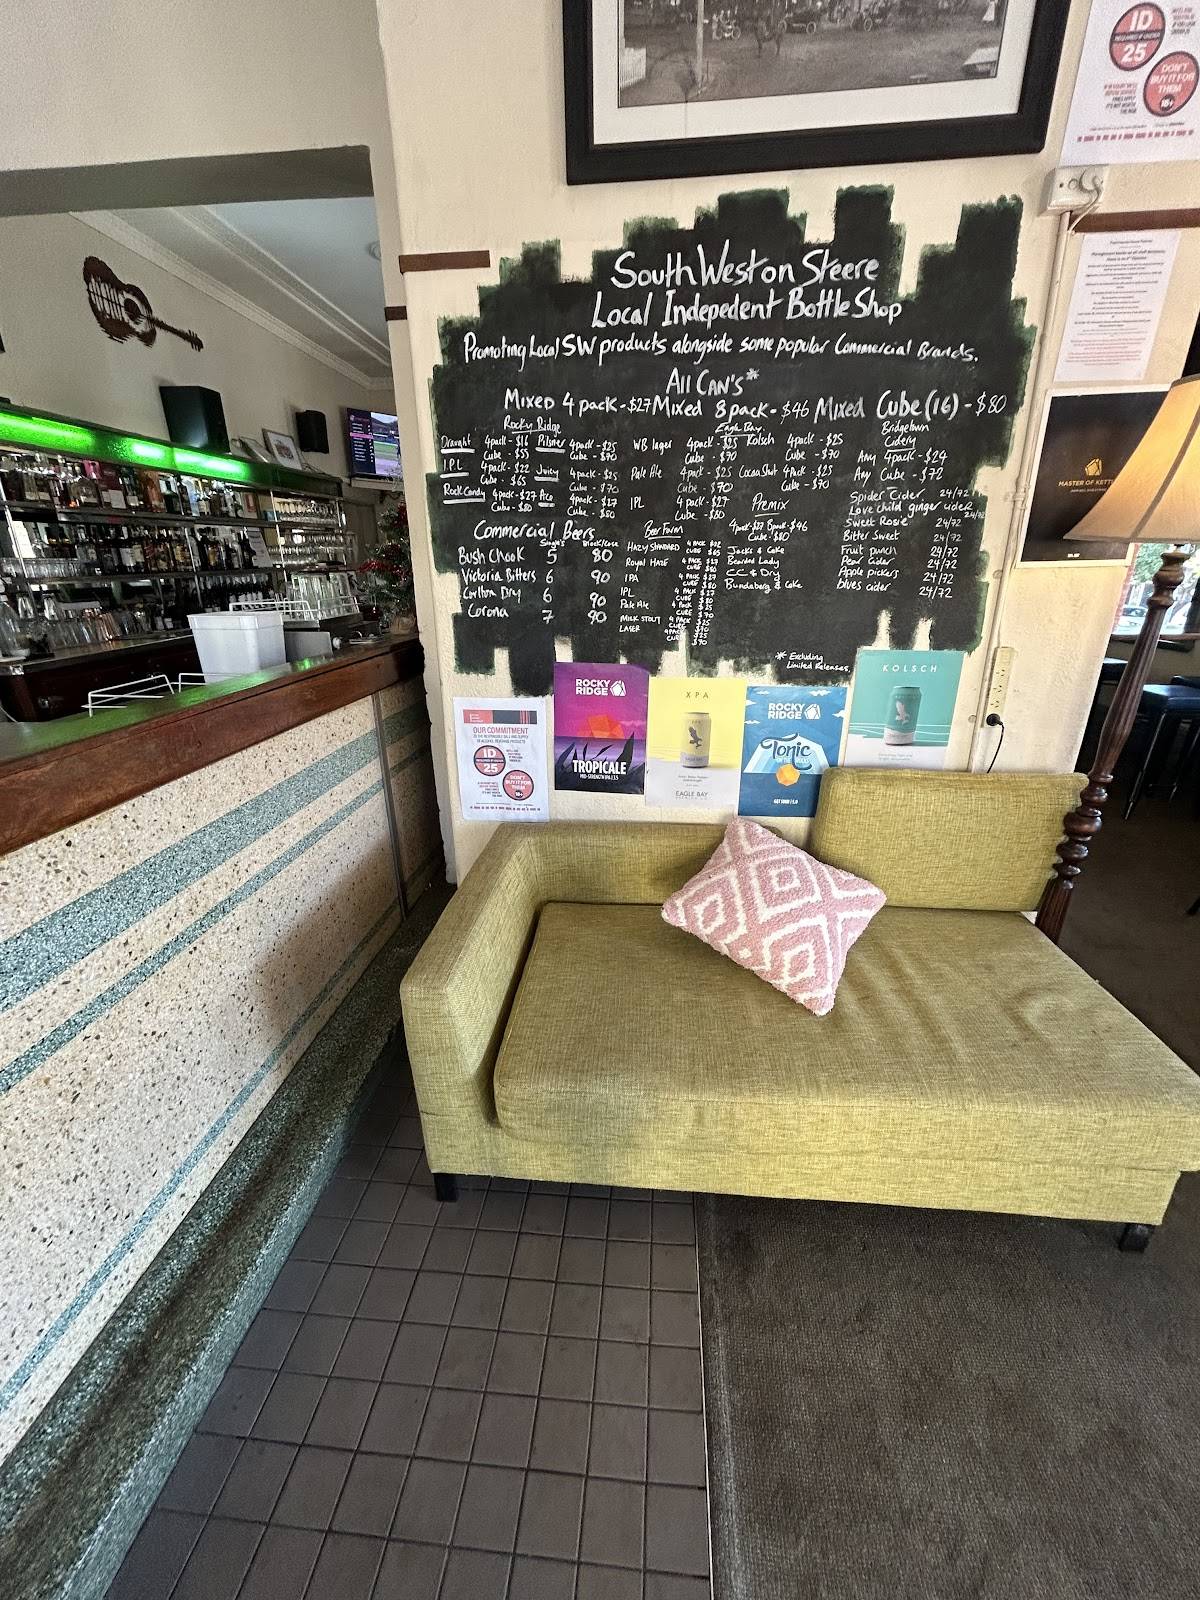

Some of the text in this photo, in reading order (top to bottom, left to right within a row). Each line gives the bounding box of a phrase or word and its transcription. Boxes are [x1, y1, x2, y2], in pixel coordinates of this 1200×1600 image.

[1130, 10, 1153, 31] ID
[1121, 43, 1147, 63] 25
[1151, 74, 1168, 85] BUY
[1178, 72, 1195, 83] FOR
[1157, 83, 1182, 93] THEM
[610, 251, 698, 288] South
[800, 248, 880, 287] Steere
[591, 286, 902, 330] Local Indepedent Bottle Shop
[464, 331, 979, 372] Promoting Local SW products alongside some popular Commercial Brands.
[665, 367, 692, 395] All
[562, 391, 575, 416] 4
[578, 395, 618, 418] pack
[652, 395, 703, 418] Mixed
[813, 396, 865, 424] Mixed
[503, 415, 561, 437] Rocky Ridge
[881, 419, 929, 435] Bridgetown
[441, 433, 566, 449] Draught Pilsner
[633, 437, 648, 452] WB
[652, 438, 672, 455] lager
[746, 432, 775, 446] Kolsch
[884, 435, 916, 448] Cidery
[483, 449, 588, 460] Cube Cube
[685, 452, 704, 464] Cube
[785, 448, 806, 461] Cube
[857, 449, 876, 467] Any
[536, 463, 559, 478] Juicy
[631, 466, 646, 480] Pale
[649, 463, 662, 478] Ale
[854, 466, 871, 487] Any
[880, 467, 905, 481] Cube
[480, 474, 588, 491] Cube Cube
[677, 482, 698, 493] Cube
[781, 479, 800, 491] Cube
[539, 488, 553, 501] Ace
[630, 492, 790, 511] IPL Premix
[849, 487, 969, 504] Spider Cider 24/72
[491, 501, 589, 516] Cube Cube
[674, 509, 698, 520] Cube
[848, 500, 941, 518] Love child ginger
[474, 519, 595, 540] Commercial Beers
[644, 520, 683, 538] Beer Farm
[843, 516, 961, 529] Sweet Rosie 24/72
[843, 529, 961, 544] Bitter Sweet 24/72
[458, 545, 613, 565] Bush Chook 5 80
[727, 545, 785, 555] Jacks Coke
[841, 544, 958, 559] Fruit punch 24/72
[727, 555, 780, 569] Bearded Lady
[841, 556, 957, 571] Pear 24/72
[461, 567, 611, 586] Victoria Bitters 6 90
[625, 574, 639, 582] IPA
[726, 568, 780, 580] CC Dry
[838, 565, 954, 585] Apple pickers 24/72
[620, 586, 635, 597] IPL
[724, 578, 803, 594] Bundaberg Coke
[866, 581, 952, 599] cider 24/72
[500, 586, 607, 609] Dry 6 90
[620, 598, 649, 610] Pale Ale
[468, 602, 607, 625] Corona 7 90
[641, 615, 660, 624] STOUT
[786, 661, 813, 670] Limited
[789, 651, 823, 664] Excluding
[575, 679, 611, 687] ROCKY
[575, 687, 608, 695] RIDGE
[768, 703, 805, 711] ROCKY
[768, 711, 802, 720] RIDGE
[483, 749, 496, 758] ID
[761, 733, 812, 770] Tonic
[484, 764, 498, 773] 25
[573, 759, 627, 775] TROPICALE
